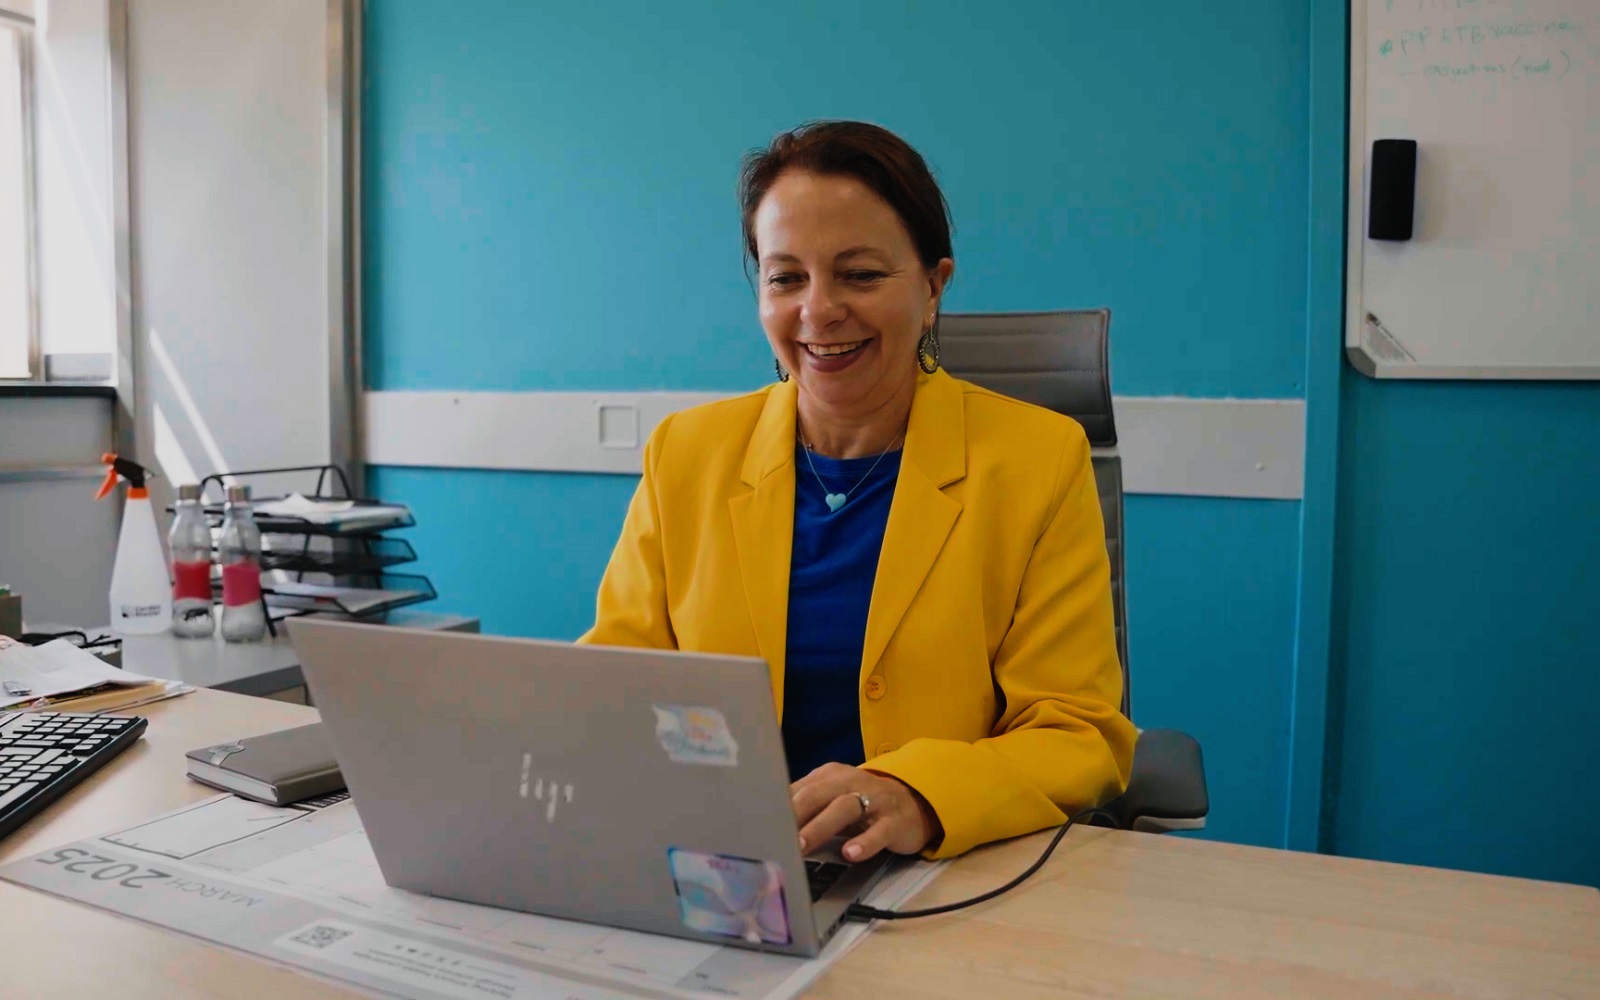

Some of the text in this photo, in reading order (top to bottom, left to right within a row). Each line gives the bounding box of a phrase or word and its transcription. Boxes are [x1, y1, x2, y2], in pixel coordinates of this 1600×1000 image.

[519, 753, 574, 822] hp
[36, 848, 264, 906] MARCH 2025
